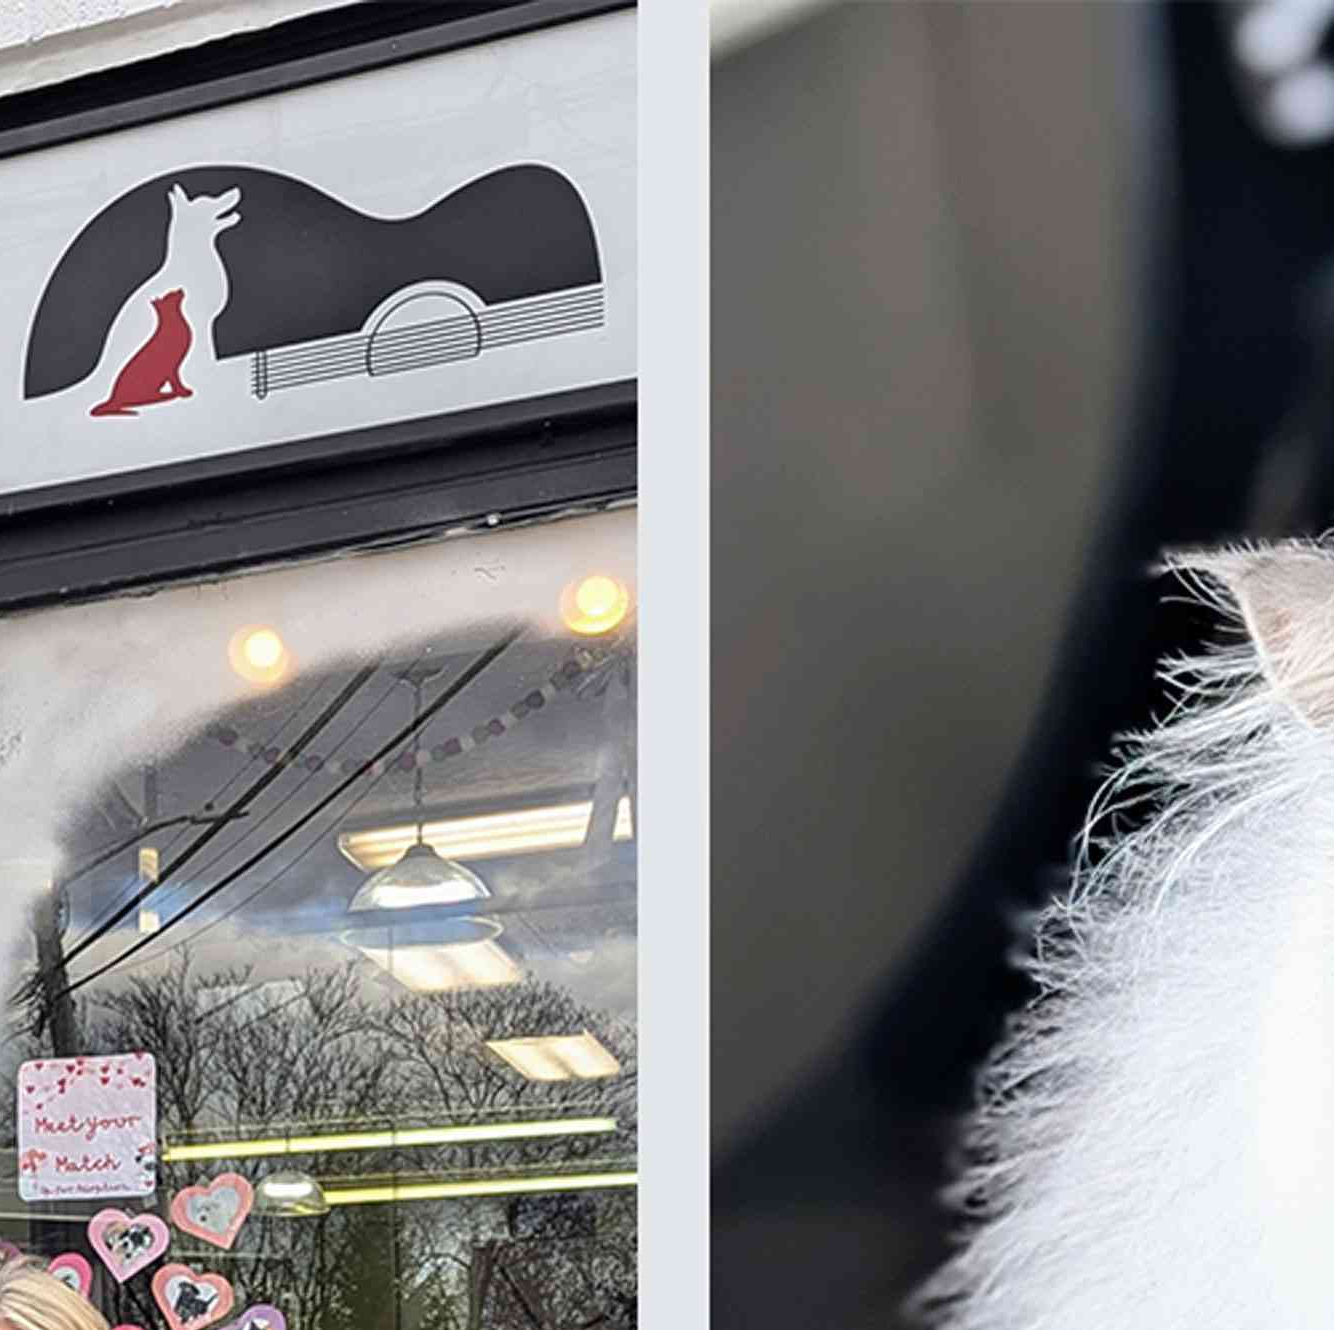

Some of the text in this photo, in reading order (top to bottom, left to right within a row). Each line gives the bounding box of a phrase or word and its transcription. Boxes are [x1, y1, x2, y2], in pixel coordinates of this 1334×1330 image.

[34, 1113, 141, 1141] Meet your
[55, 1153, 121, 1173] Match
